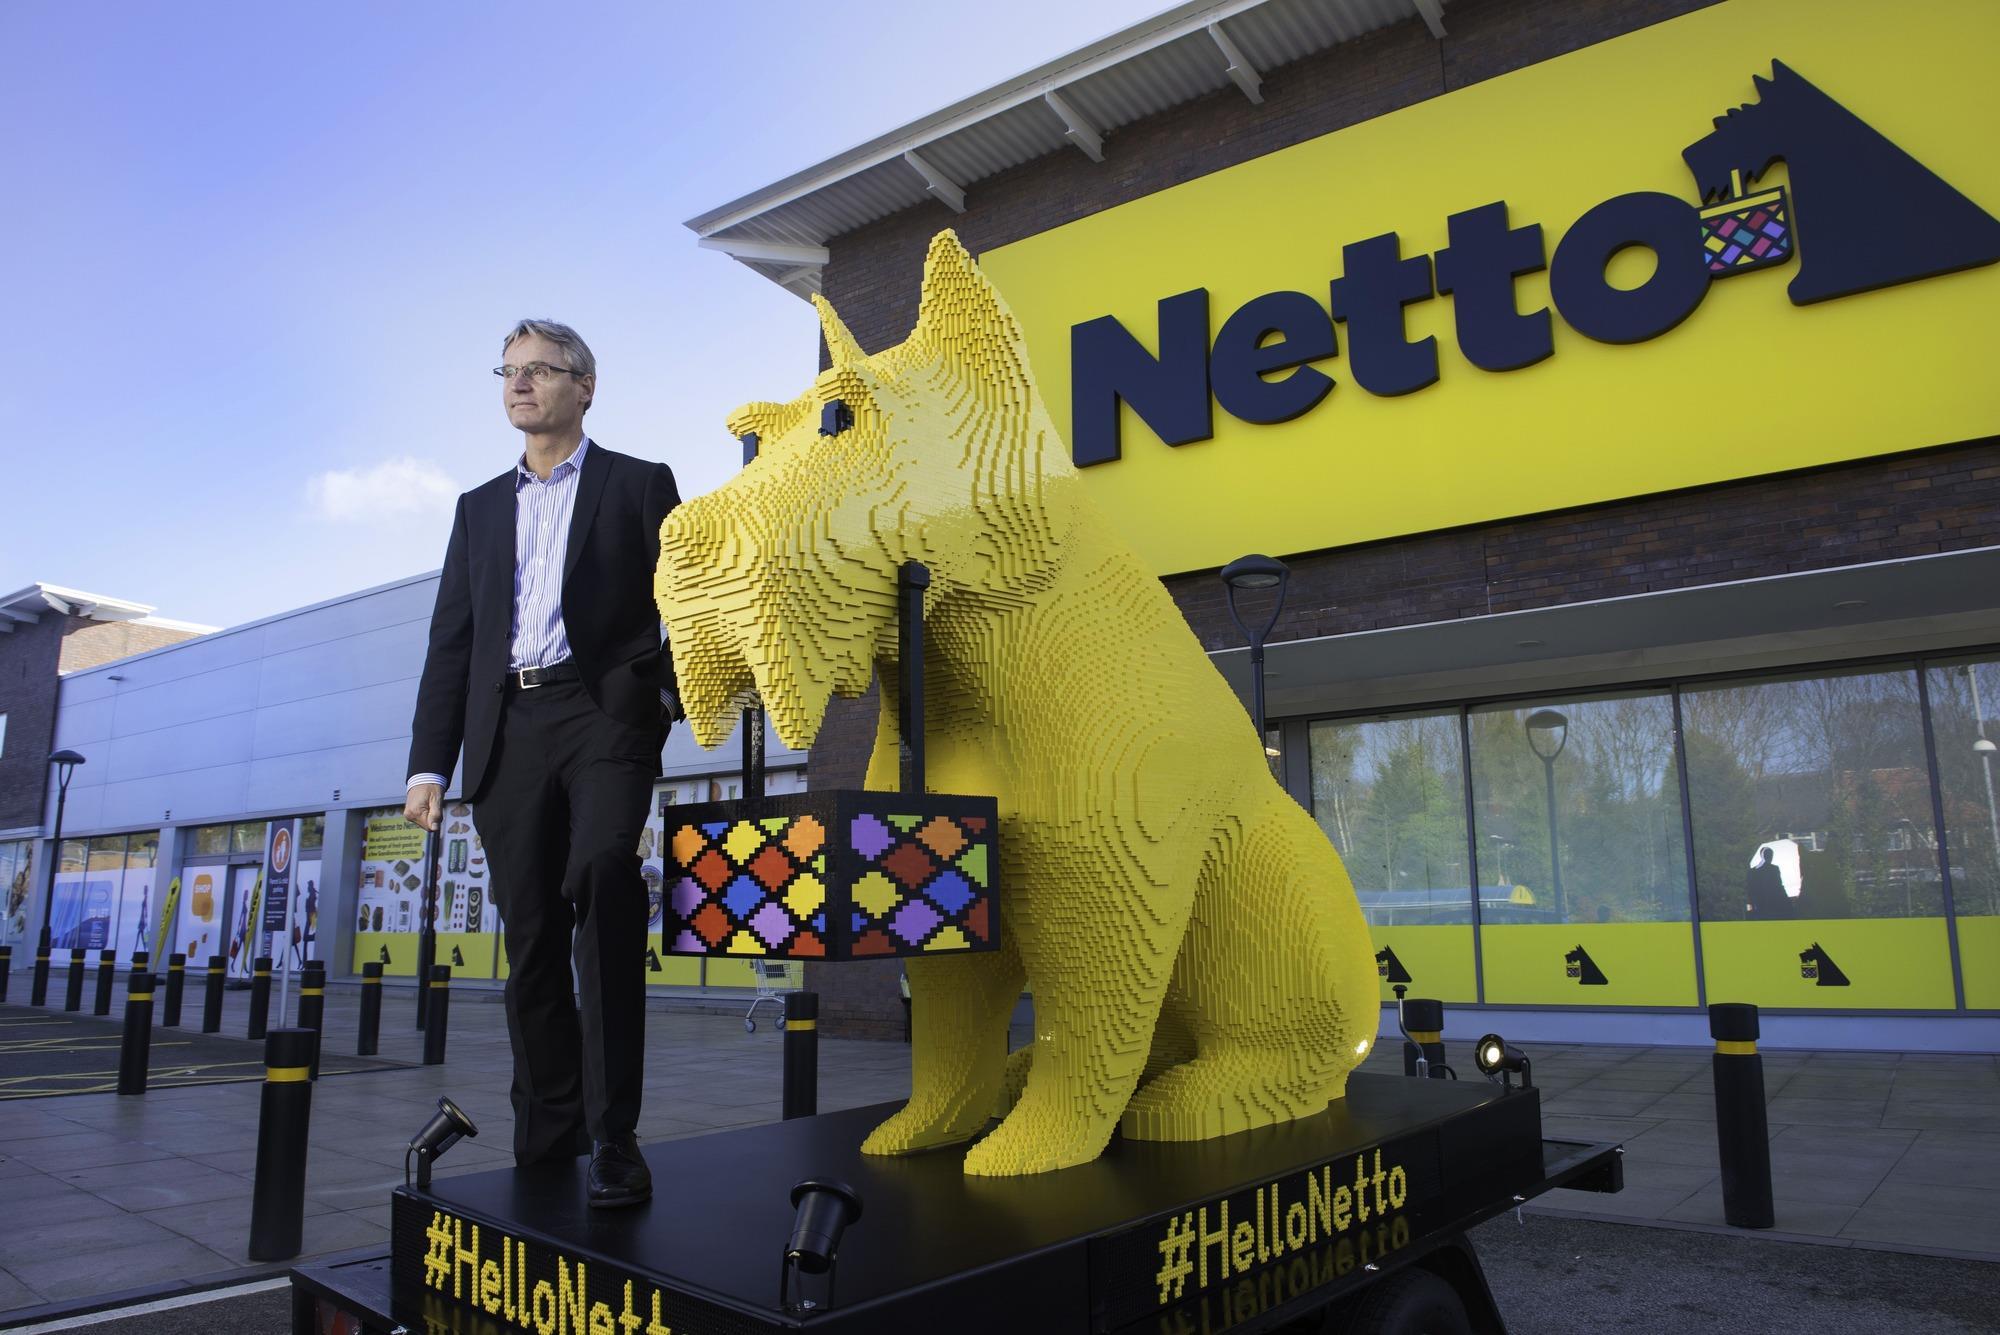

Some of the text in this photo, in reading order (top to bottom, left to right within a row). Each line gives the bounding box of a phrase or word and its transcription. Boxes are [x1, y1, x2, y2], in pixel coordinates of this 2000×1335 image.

[1071, 191, 1714, 468] Netto
[194, 884, 211, 894] SHOP
[424, 1211, 673, 1335] #HelloNett
[1156, 1148, 1407, 1305] #HelloNetto
